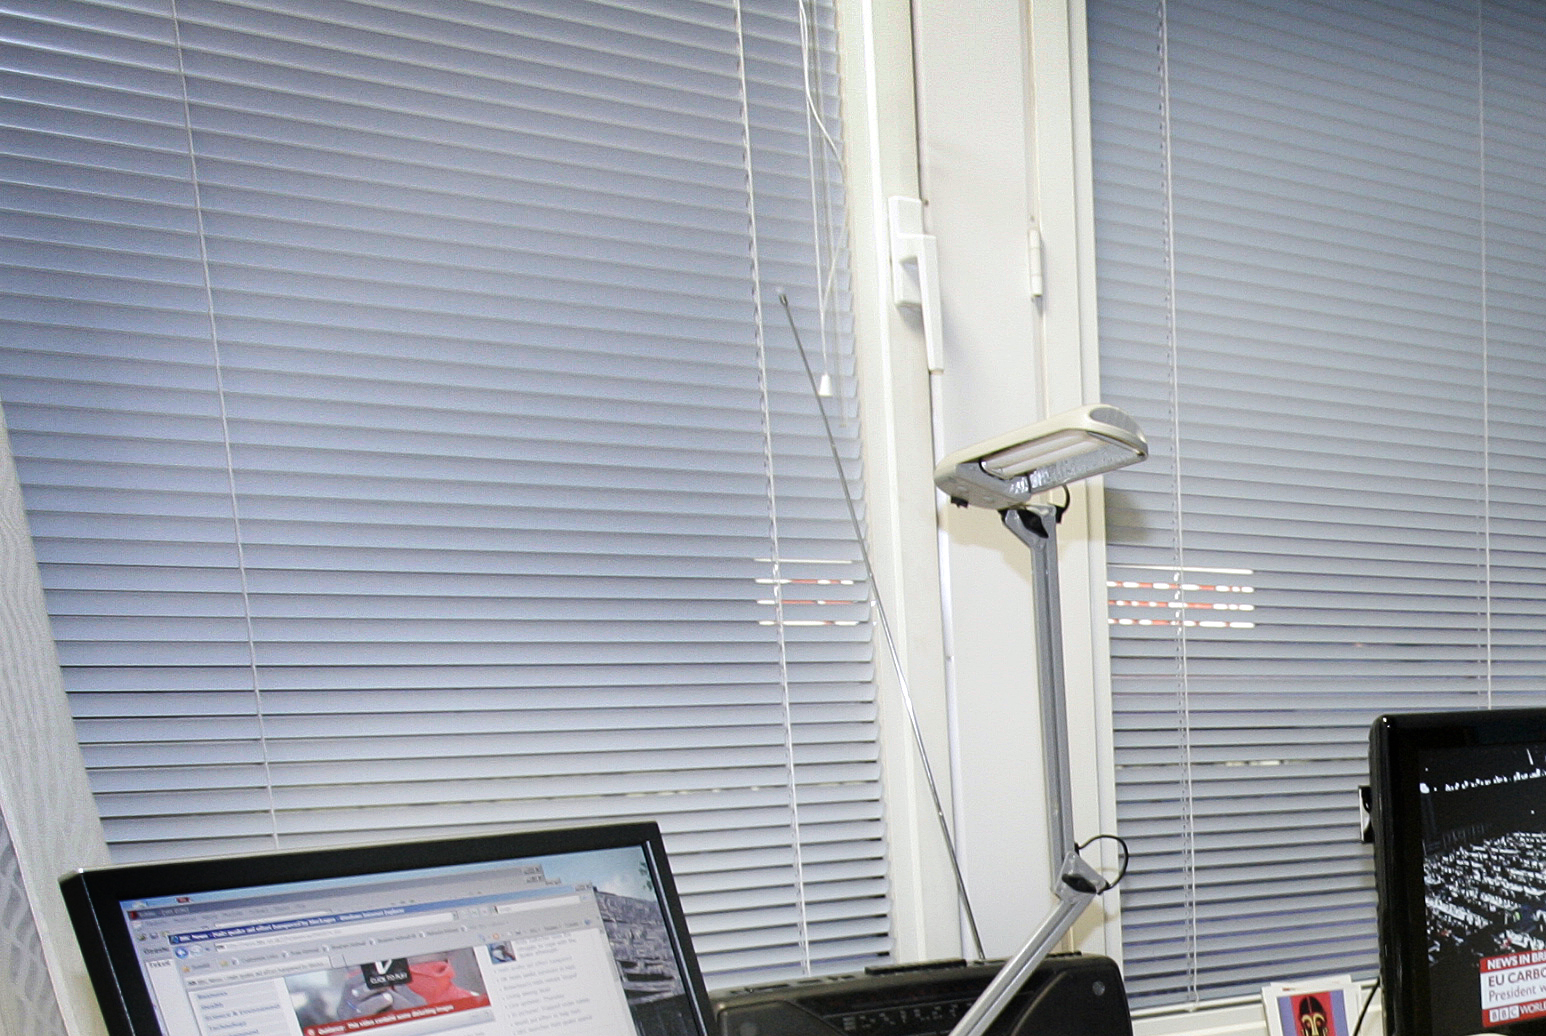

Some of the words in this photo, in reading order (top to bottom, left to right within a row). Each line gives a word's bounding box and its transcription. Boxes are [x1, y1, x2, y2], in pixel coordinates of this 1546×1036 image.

[1487, 957, 1516, 970] NEWS
[1518, 954, 1528, 965] IN
[1488, 974, 1505, 987] EU
[1488, 985, 1536, 1002] President
[1490, 1005, 1520, 1023] BBC
